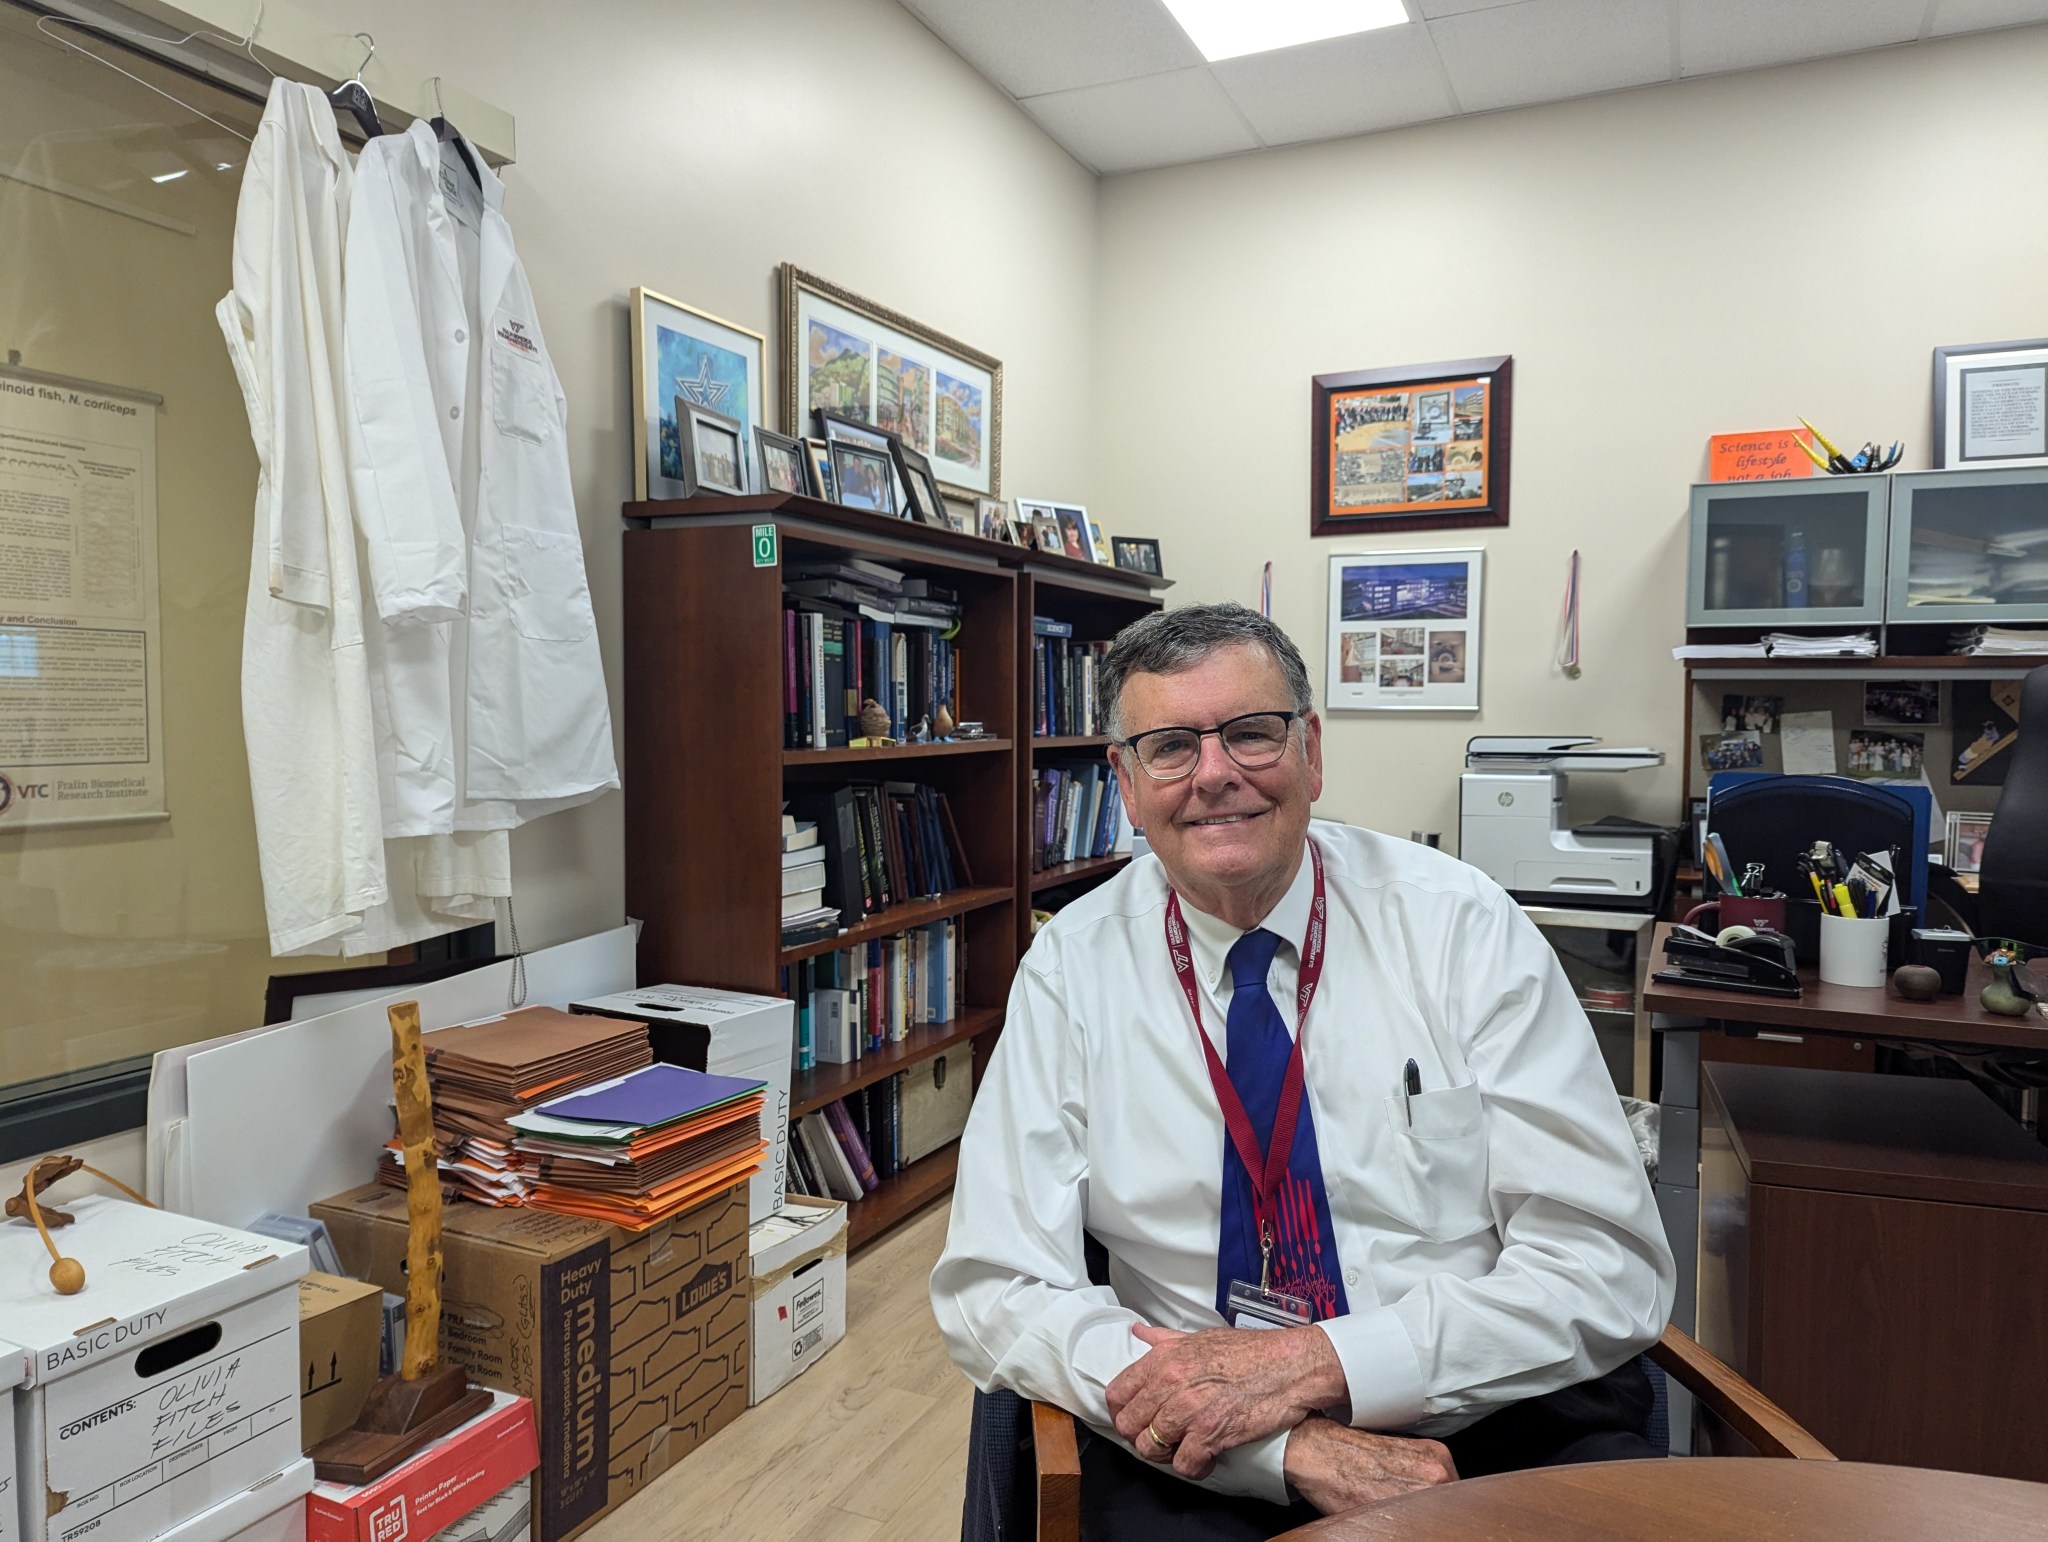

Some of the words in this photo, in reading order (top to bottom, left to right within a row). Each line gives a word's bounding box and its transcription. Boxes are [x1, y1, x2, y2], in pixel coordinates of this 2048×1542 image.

[0, 381, 34, 397] inoid
[38, 387, 65, 404] fish,
[1719, 442, 1772, 454] Science
[1778, 440, 1789, 449] is
[1736, 453, 1787, 470] lifestyle
[1728, 474, 1749, 482] not
[756, 527, 774, 538] MILE
[27, 615, 78, 626] Conclusion
[17, 784, 48, 799] VTC
[57, 780, 88, 790] Fralin
[91, 777, 145, 789] Biomedical
[57, 790, 103, 800] Research
[105, 788, 148, 799] Institute
[1315, 896, 1325, 920] VT
[1173, 949, 1189, 973] VT
[1300, 983, 1313, 1007] VT
[777, 1090, 788, 1144] DUTY
[773, 1148, 786, 1210] BASIC
[181, 1233, 268, 1255] OLIVIA
[561, 1258, 602, 1287] Heavy
[561, 1279, 592, 1304] Duty
[682, 1271, 727, 1311] LOWE'S
[448, 1327, 487, 1346] Bedroom
[564, 1309, 573, 1341] Para
[47, 1333, 110, 1371] BASIC
[115, 1307, 167, 1343] DUTY
[448, 1342, 476, 1359] Family
[477, 1350, 503, 1365] Room
[477, 1364, 503, 1380] Room
[159, 1358, 241, 1411] OLIVIA
[562, 1368, 572, 1420] pesado,
[577, 1297, 602, 1471] medium
[59, 1400, 137, 1441] CONTENTS:
[152, 1383, 227, 1436] FITCH
[151, 1401, 241, 1459] FILES
[223, 1426, 238, 1436] FROM
[168, 1450, 191, 1464] DESTROY
[563, 1421, 572, 1479] mediana
[119, 1480, 131, 1488] BOX
[132, 1465, 158, 1482] LOCATION
[415, 1485, 438, 1506] Printer
[438, 1475, 457, 1491] Paper
[416, 1506, 428, 1516] Best
[435, 1493, 448, 1504] Black
[452, 1481, 466, 1493] White
[466, 1469, 486, 1484] Printing
[77, 1500, 88, 1508] BOX
[61, 1519, 101, 1542] TR59208
[376, 1508, 400, 1530] TRU
[378, 1522, 401, 1541] RED
